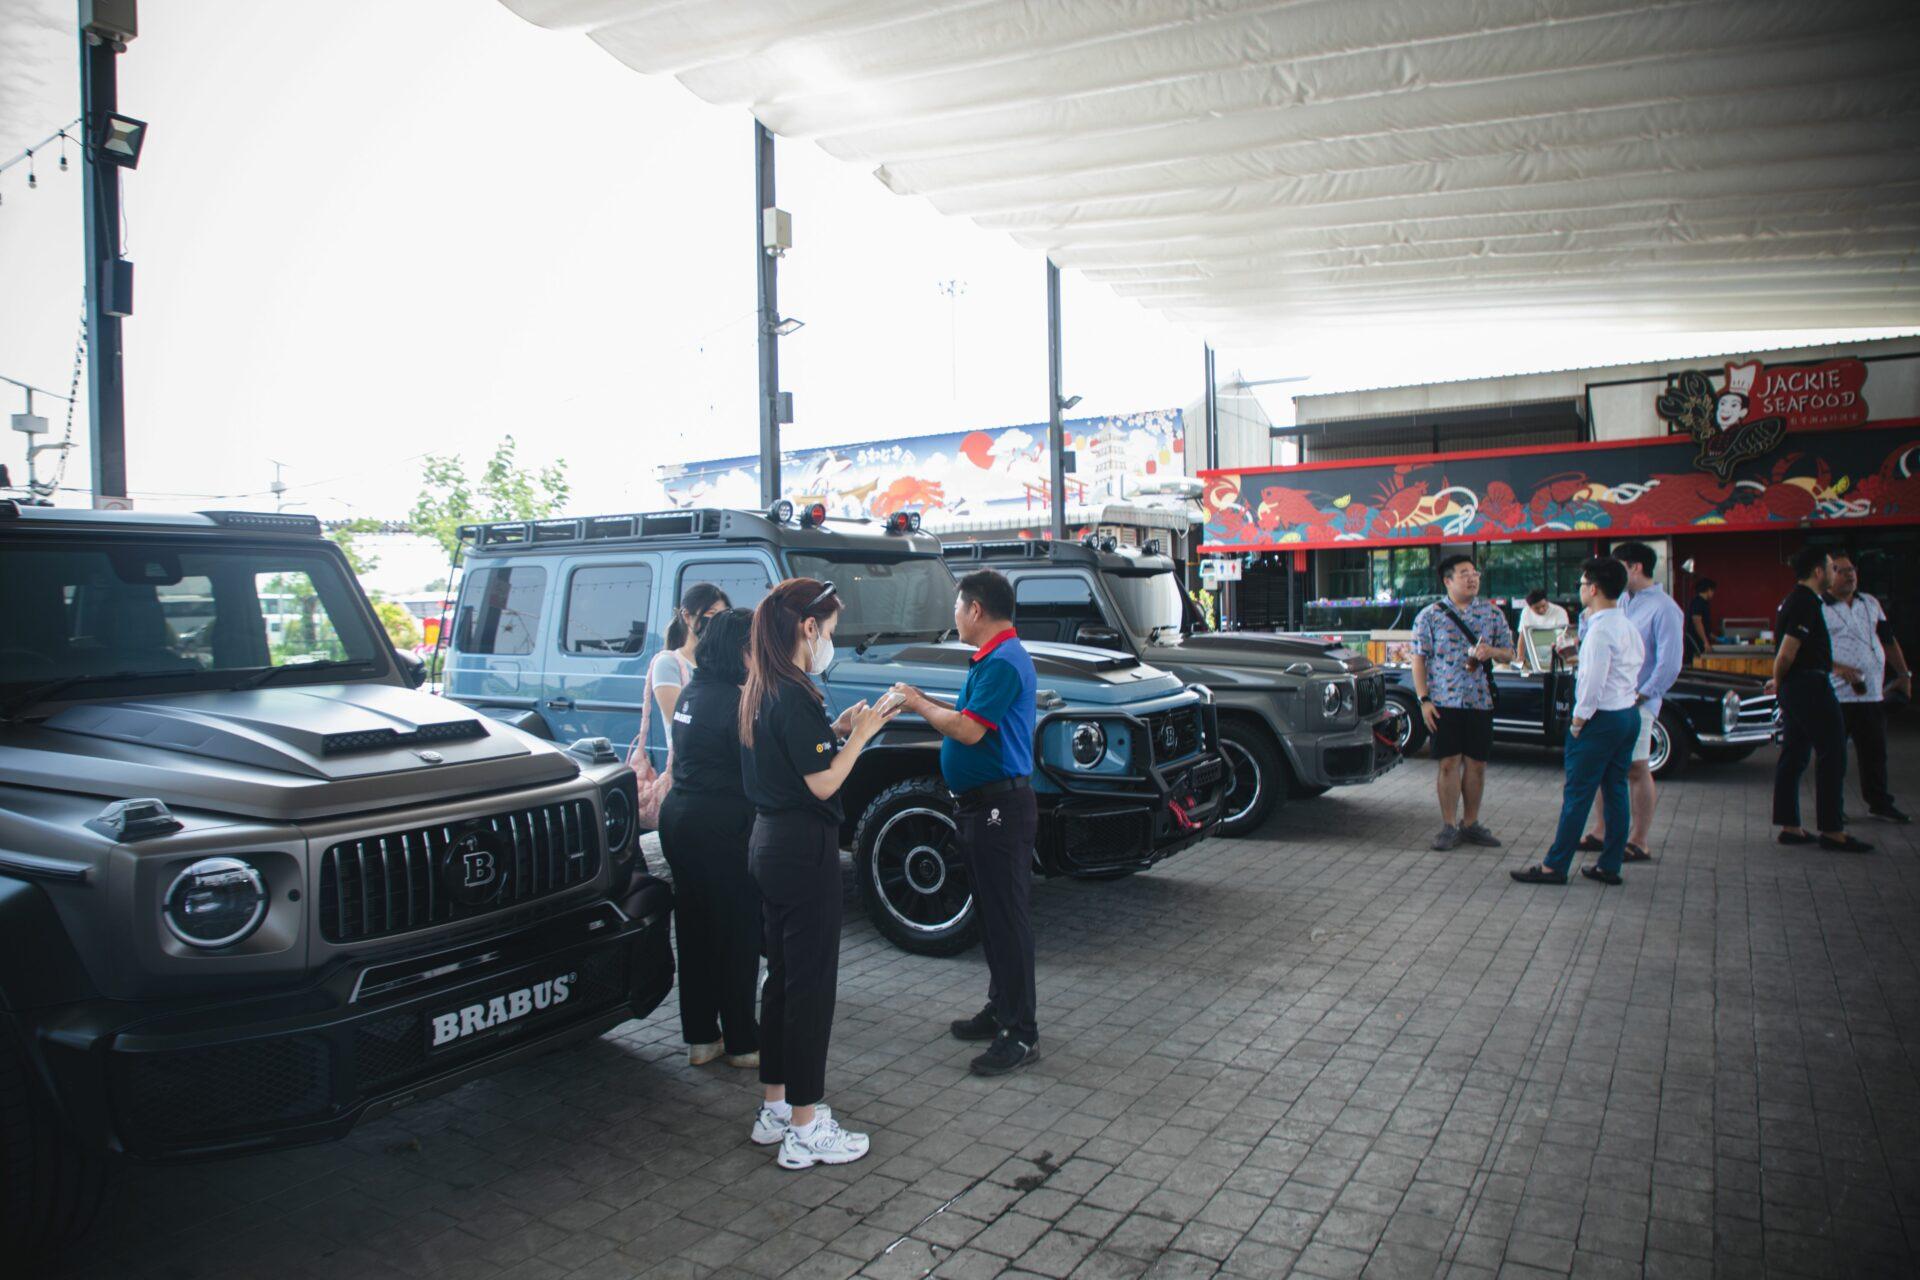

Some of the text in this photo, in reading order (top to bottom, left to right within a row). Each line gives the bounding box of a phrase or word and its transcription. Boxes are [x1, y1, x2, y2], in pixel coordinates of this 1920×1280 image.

[1757, 369, 1840, 398] JACKIE
[1763, 391, 1855, 414] SEAFOOD
[464, 851, 495, 887] B
[432, 975, 570, 1047] BRABUS
